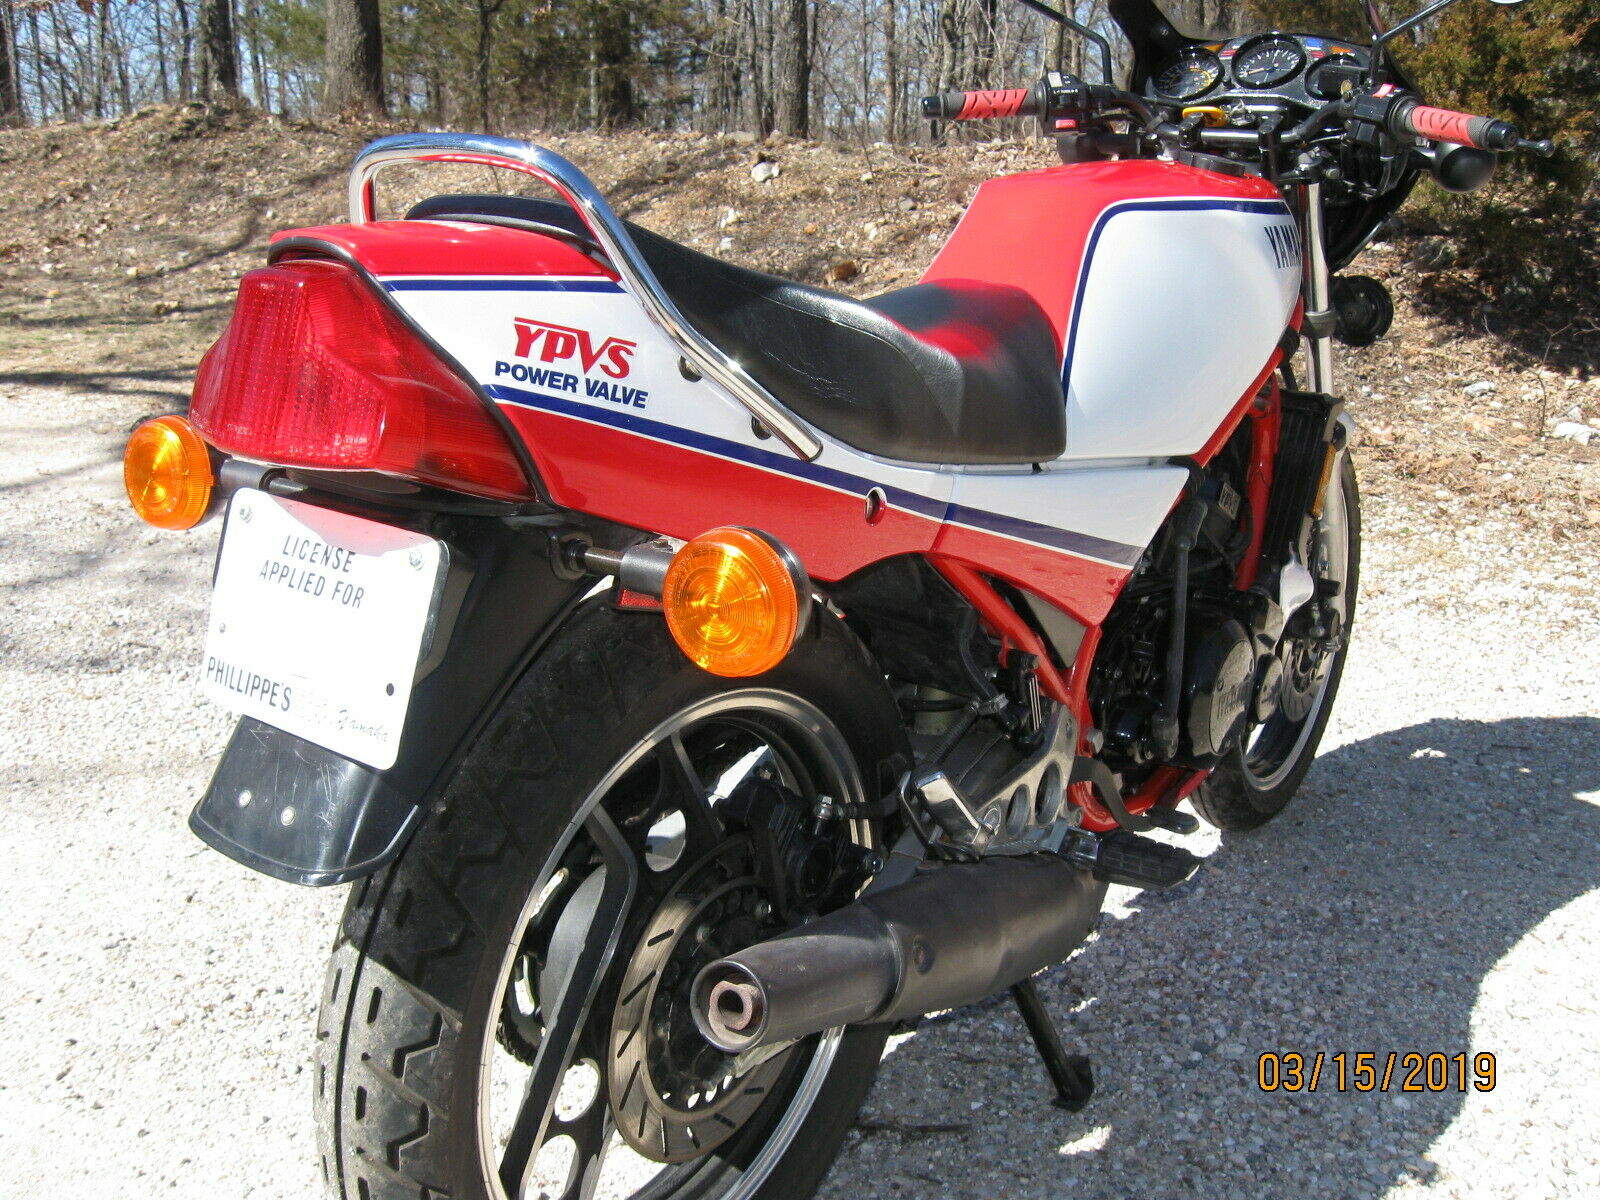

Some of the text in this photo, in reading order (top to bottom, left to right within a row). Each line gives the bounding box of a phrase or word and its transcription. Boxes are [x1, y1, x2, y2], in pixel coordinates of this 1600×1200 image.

[514, 317, 637, 379] YPVS
[495, 360, 649, 409] POWER VALVE
[282, 535, 356, 573] LICENSE
[260, 560, 365, 608] APPLIED FOR
